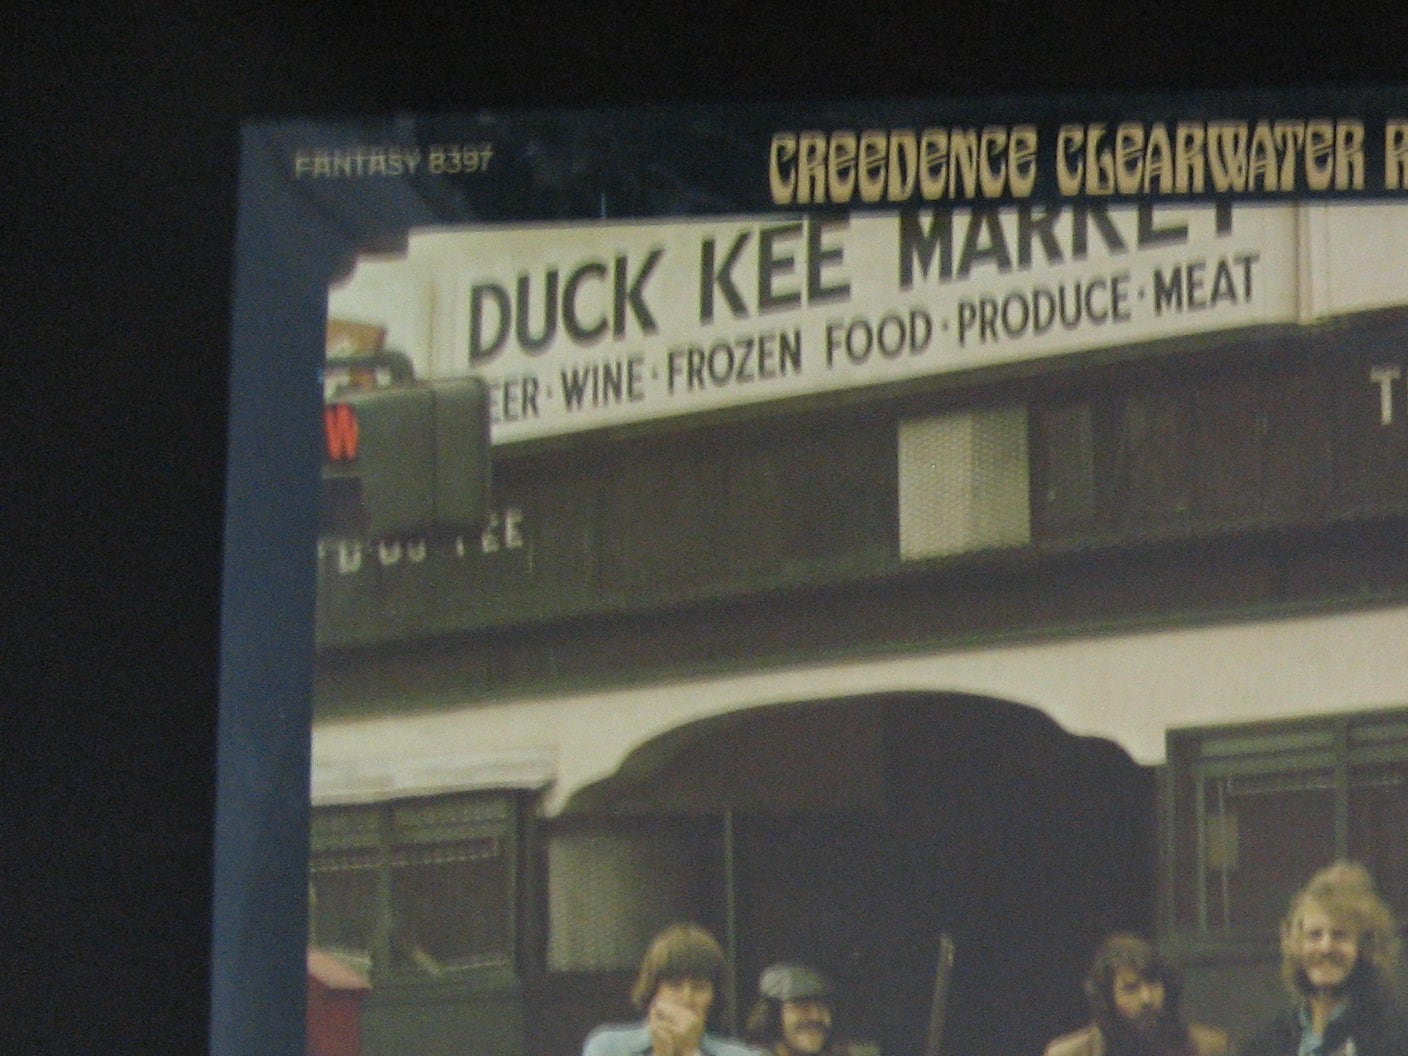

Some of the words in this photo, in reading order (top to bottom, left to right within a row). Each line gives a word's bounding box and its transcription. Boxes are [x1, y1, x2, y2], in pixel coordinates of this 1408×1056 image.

[295, 150, 420, 178] FANTASY
[428, 143, 494, 175] 8397
[768, 128, 1039, 204] CREEDENCE
[1055, 121, 1365, 197] CLEARWATER
[468, 248, 665, 367] DUCK
[699, 211, 852, 325] KEE
[558, 353, 645, 413] WINE
[665, 328, 802, 395] FROZEN
[824, 308, 934, 370] FOOD
[957, 270, 1132, 346] PRODUCE
[1151, 251, 1262, 317] MEAT
